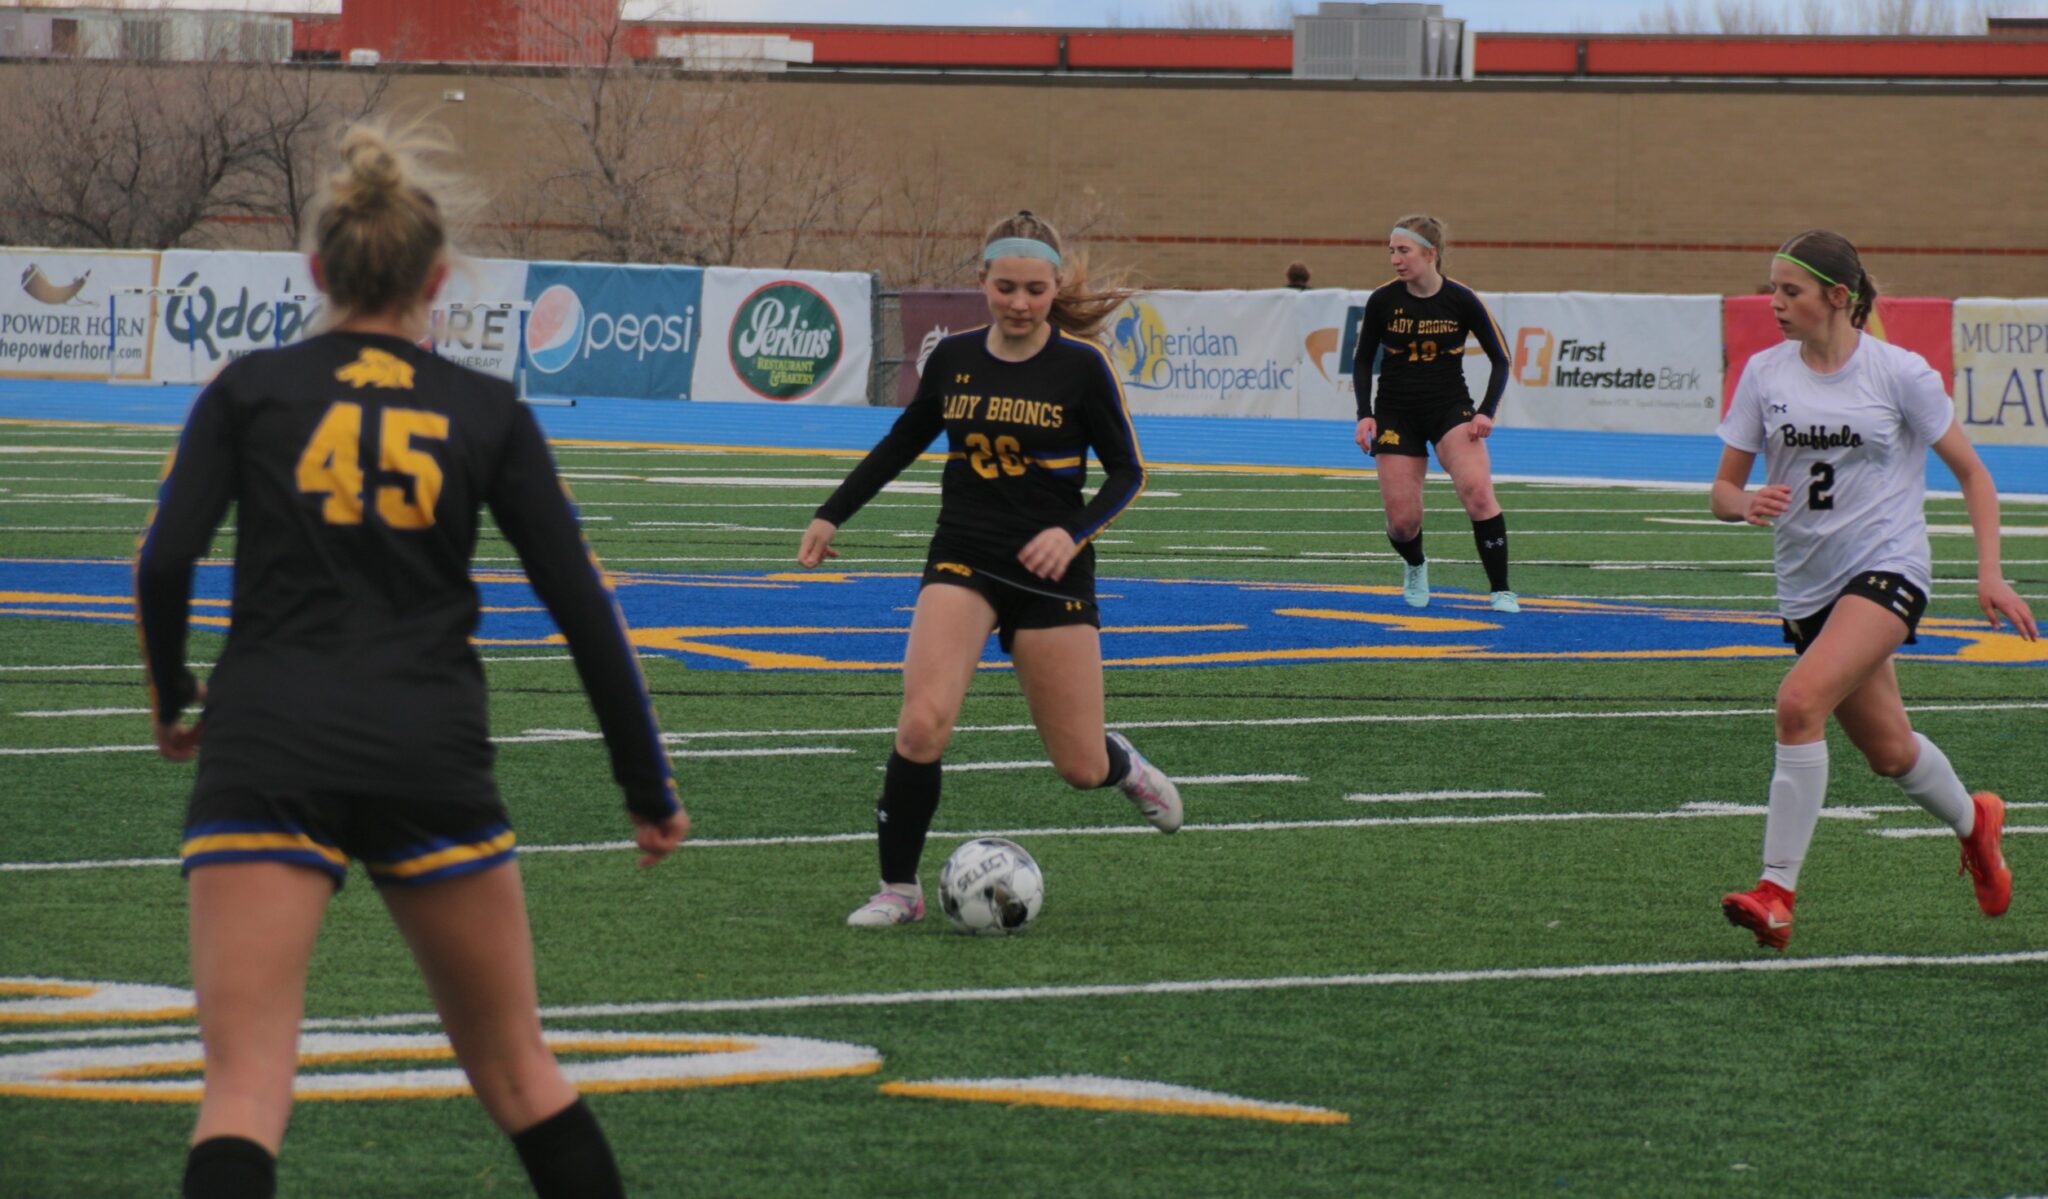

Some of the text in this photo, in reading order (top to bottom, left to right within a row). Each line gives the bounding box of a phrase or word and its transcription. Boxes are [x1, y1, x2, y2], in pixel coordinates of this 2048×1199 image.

[1, 313, 146, 337] POWDER HORN
[166, 270, 325, 361] Qdob
[584, 305, 694, 361] pepsi
[738, 297, 832, 359] Perkins
[1387, 318, 1459, 334] LADY BRONCS
[757, 356, 815, 372] RESTAURANT
[1558, 339, 1606, 362] First
[1556, 368, 1700, 391] Interstate Bank
[986, 397, 1063, 428] BRONCS
[1781, 423, 1863, 449] Buffalo
[295, 401, 450, 530] 45
[965, 433, 1027, 480] 26
[1808, 461, 1836, 511] 2
[957, 852, 1008, 893] SELECT
